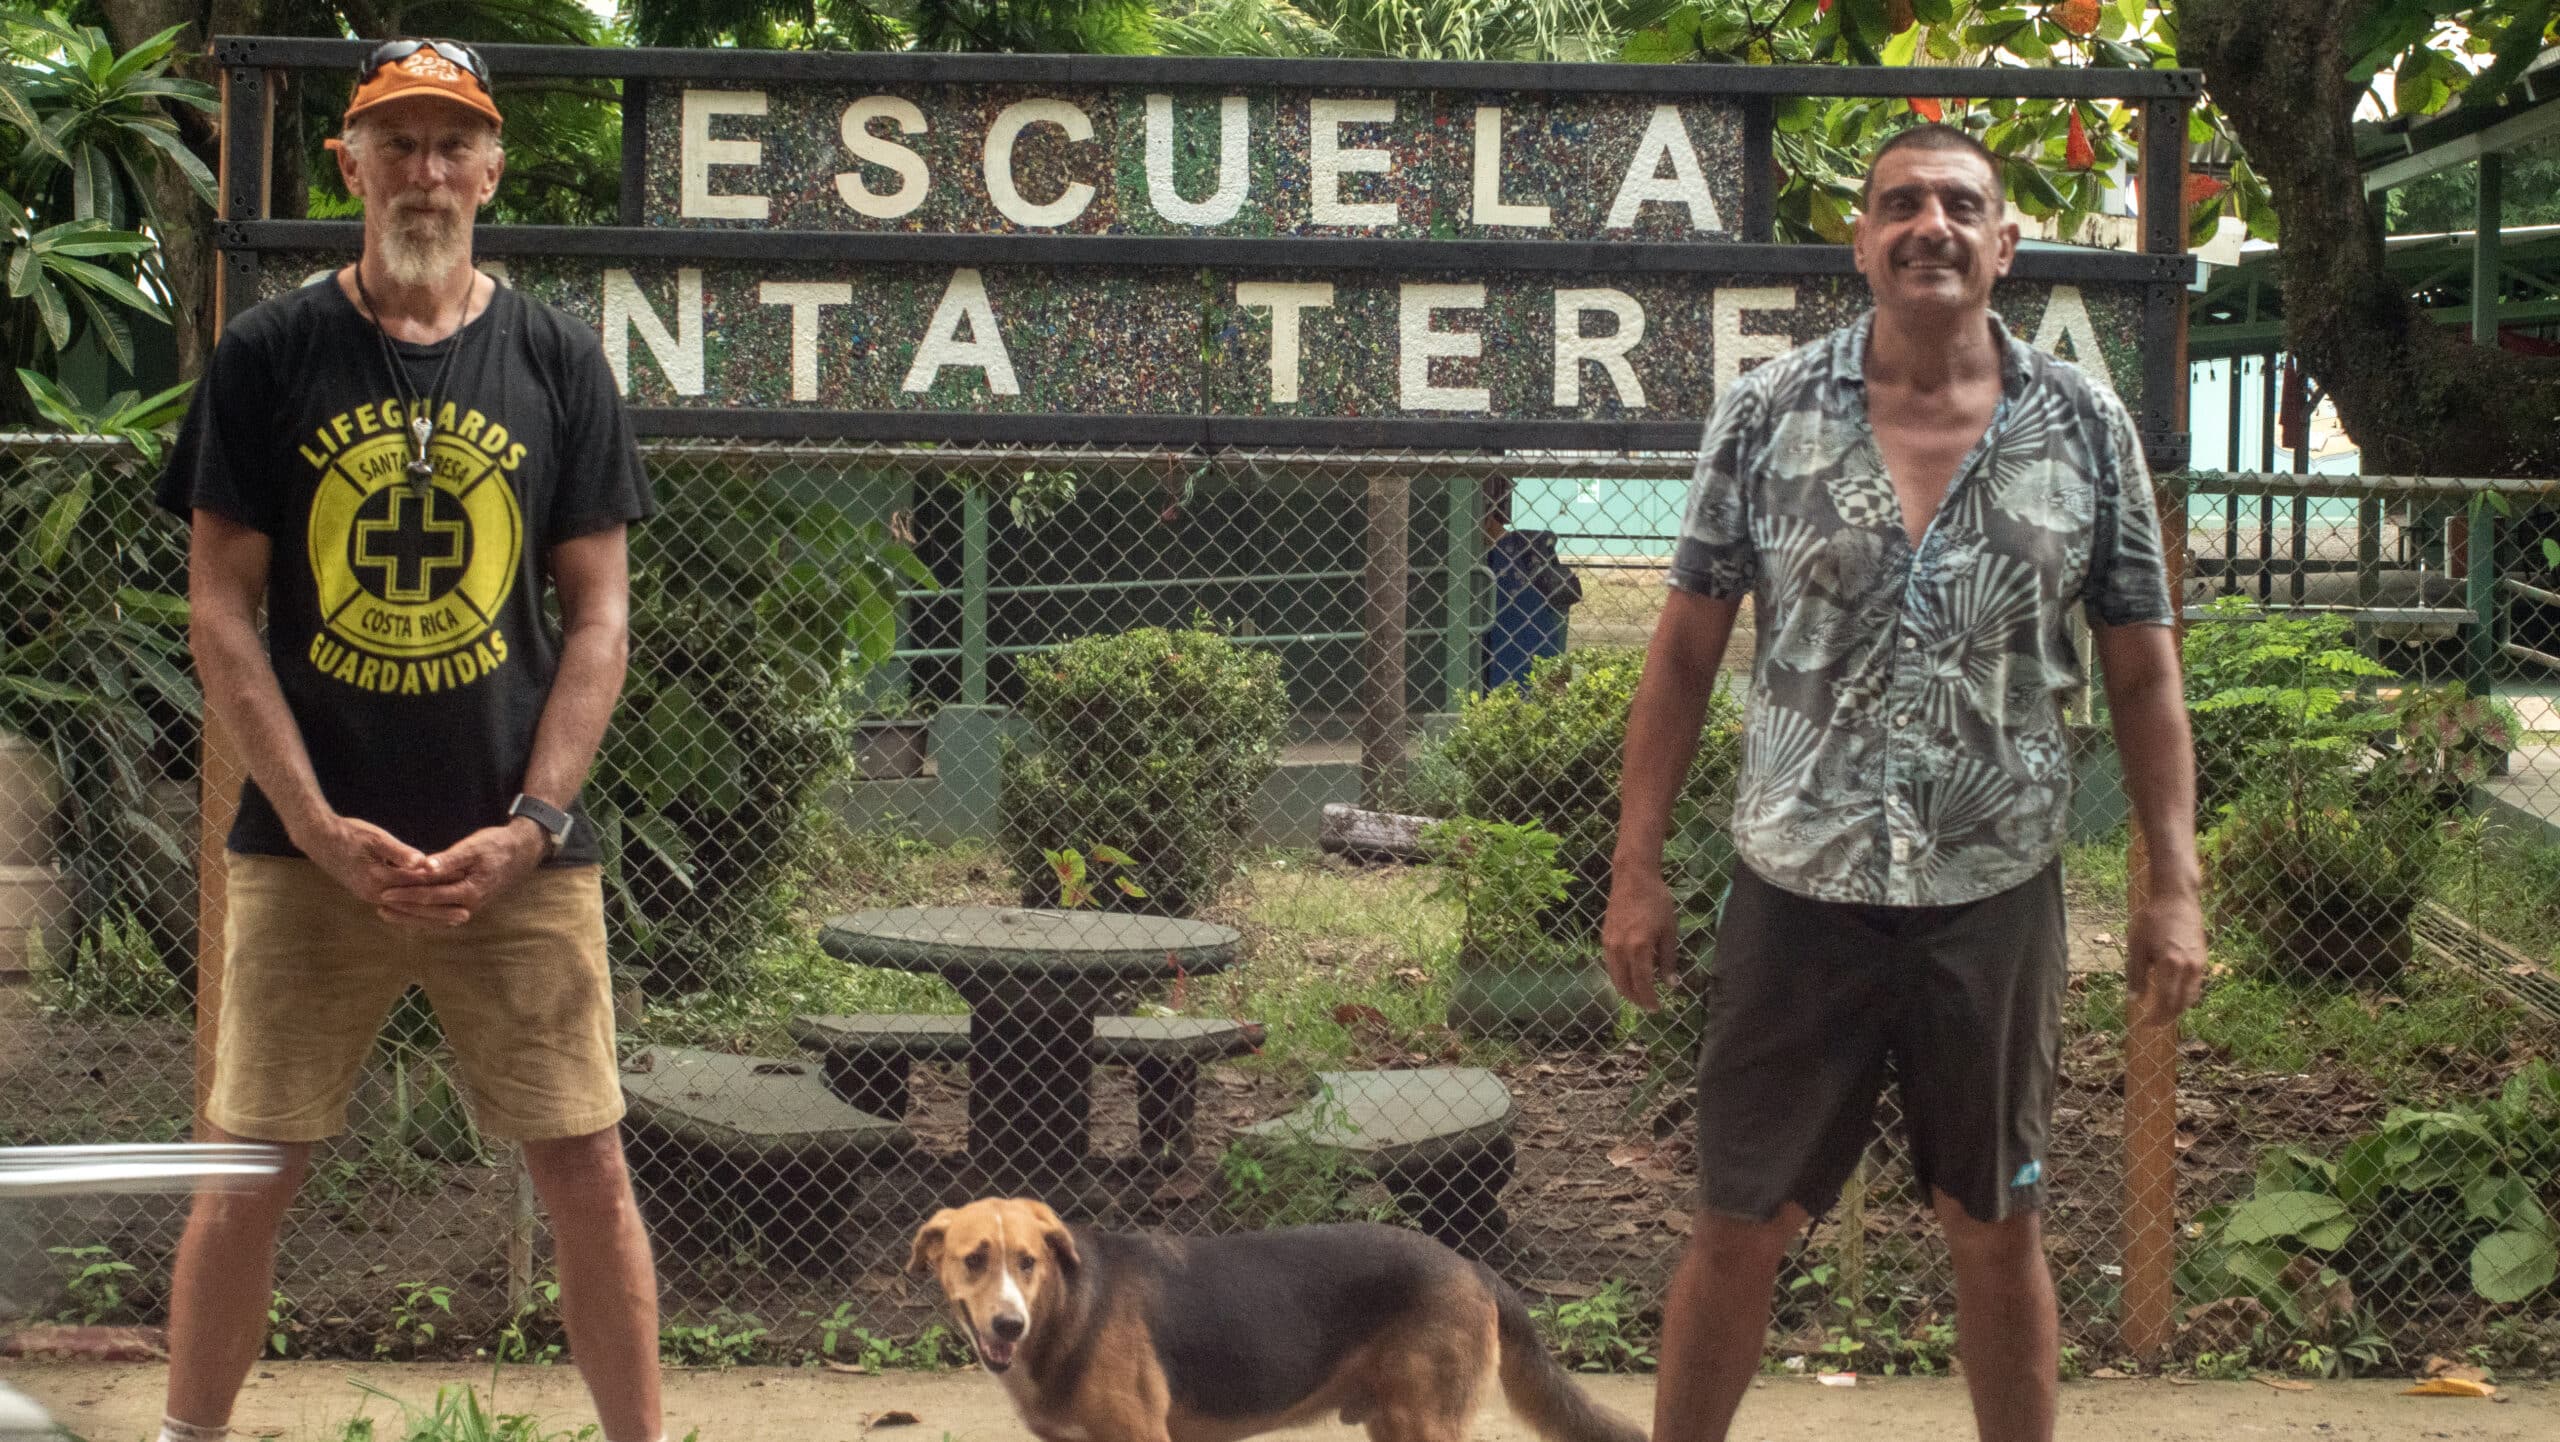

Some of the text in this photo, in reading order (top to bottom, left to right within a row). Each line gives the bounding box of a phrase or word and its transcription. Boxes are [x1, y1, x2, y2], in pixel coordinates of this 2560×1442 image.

[681, 89, 1723, 231] ESCUELA
[300, 261, 2117, 412] NTA TEREA
[359, 451, 470, 486] SANTA RESA
[361, 606, 461, 638] COSTA RICA
[309, 629, 509, 696] GUARDAVIDAS
